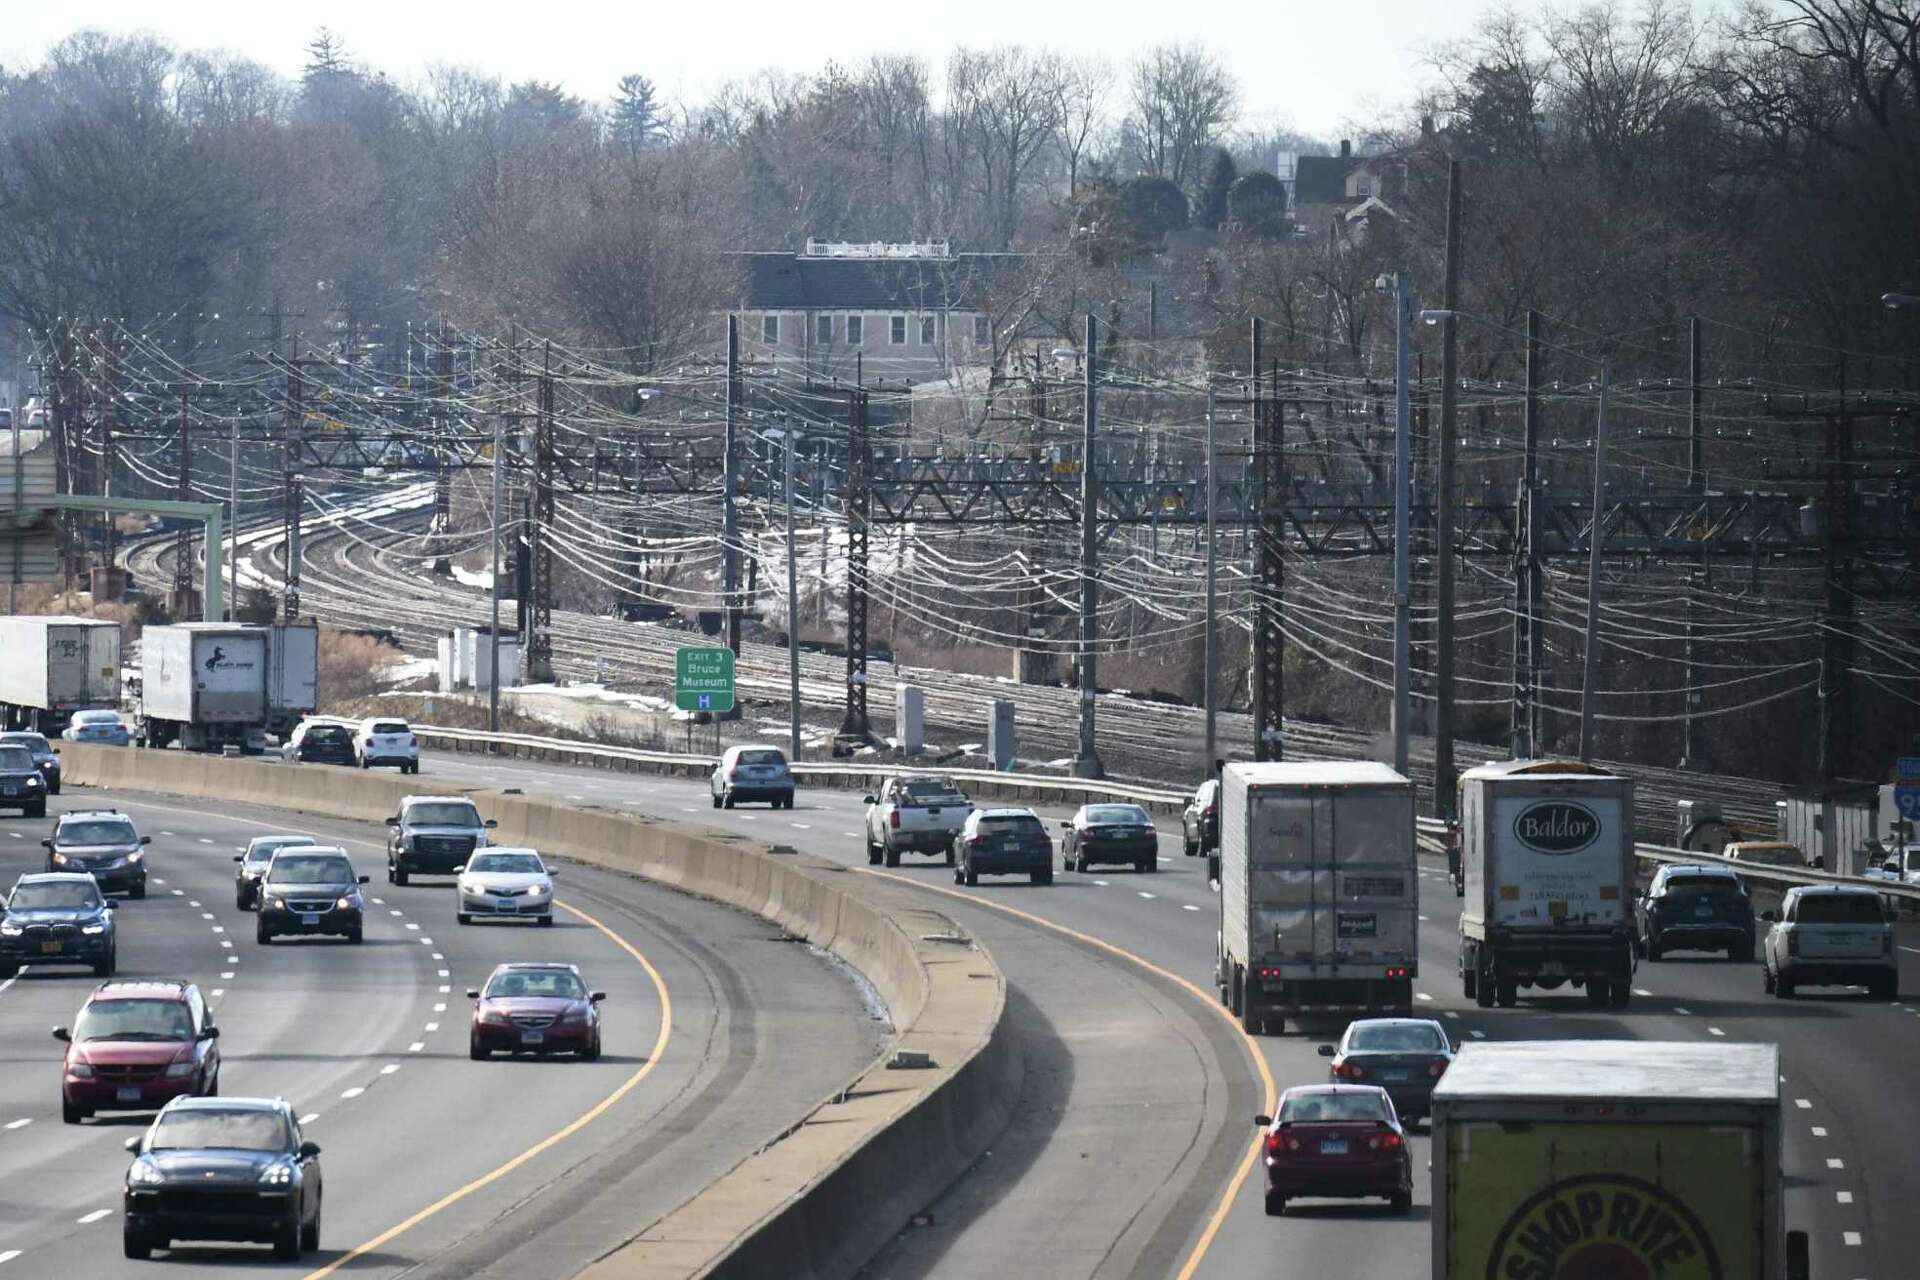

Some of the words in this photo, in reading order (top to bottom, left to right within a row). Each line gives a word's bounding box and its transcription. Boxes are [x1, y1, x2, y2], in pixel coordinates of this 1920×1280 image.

[688, 653, 710, 661] EXIT
[716, 653, 723, 662] 3
[688, 664, 721, 673] Bruce
[683, 677, 727, 687] Museum
[699, 695, 710, 708] H
[1524, 808, 1589, 838] Baldor
[1505, 1190, 1697, 1280] SHOPRITE
